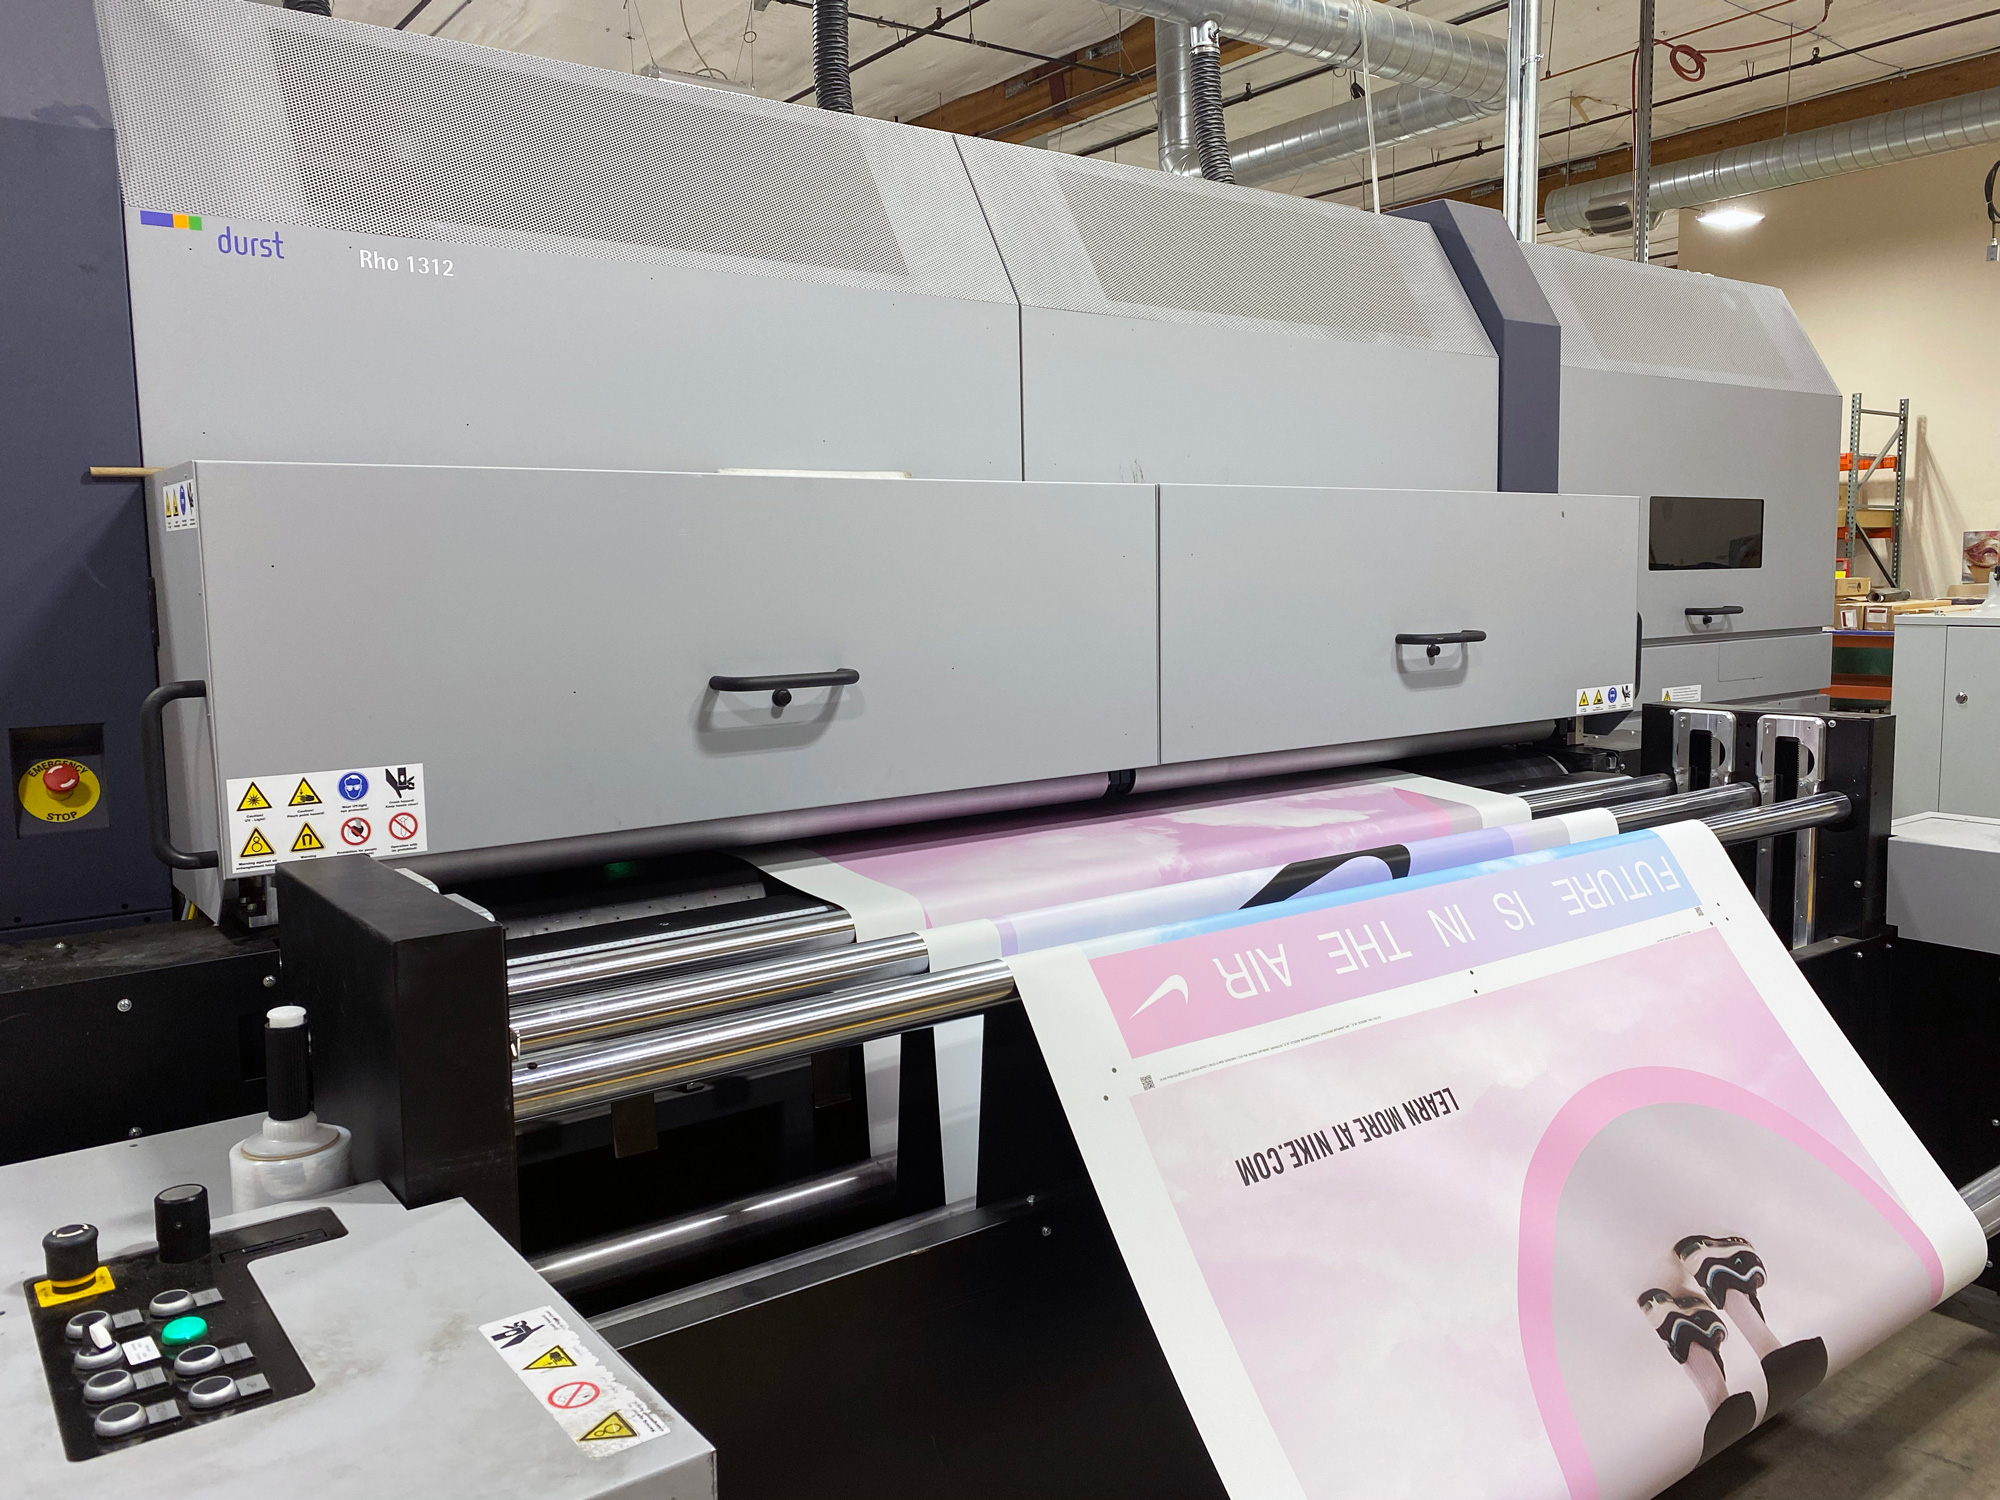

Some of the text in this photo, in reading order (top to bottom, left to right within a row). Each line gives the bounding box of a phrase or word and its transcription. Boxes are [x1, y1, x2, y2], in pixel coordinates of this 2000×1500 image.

[218, 226, 284, 259] durst
[360, 249, 454, 277] Rho 1312
[28, 760, 88, 777] EMERGENCY
[46, 811, 77, 821] STOP
[1211, 855, 1682, 1000] FUTURE IS IN THE AIR
[1234, 1087, 1460, 1187] LEARN MORE AT NIKE.COM
